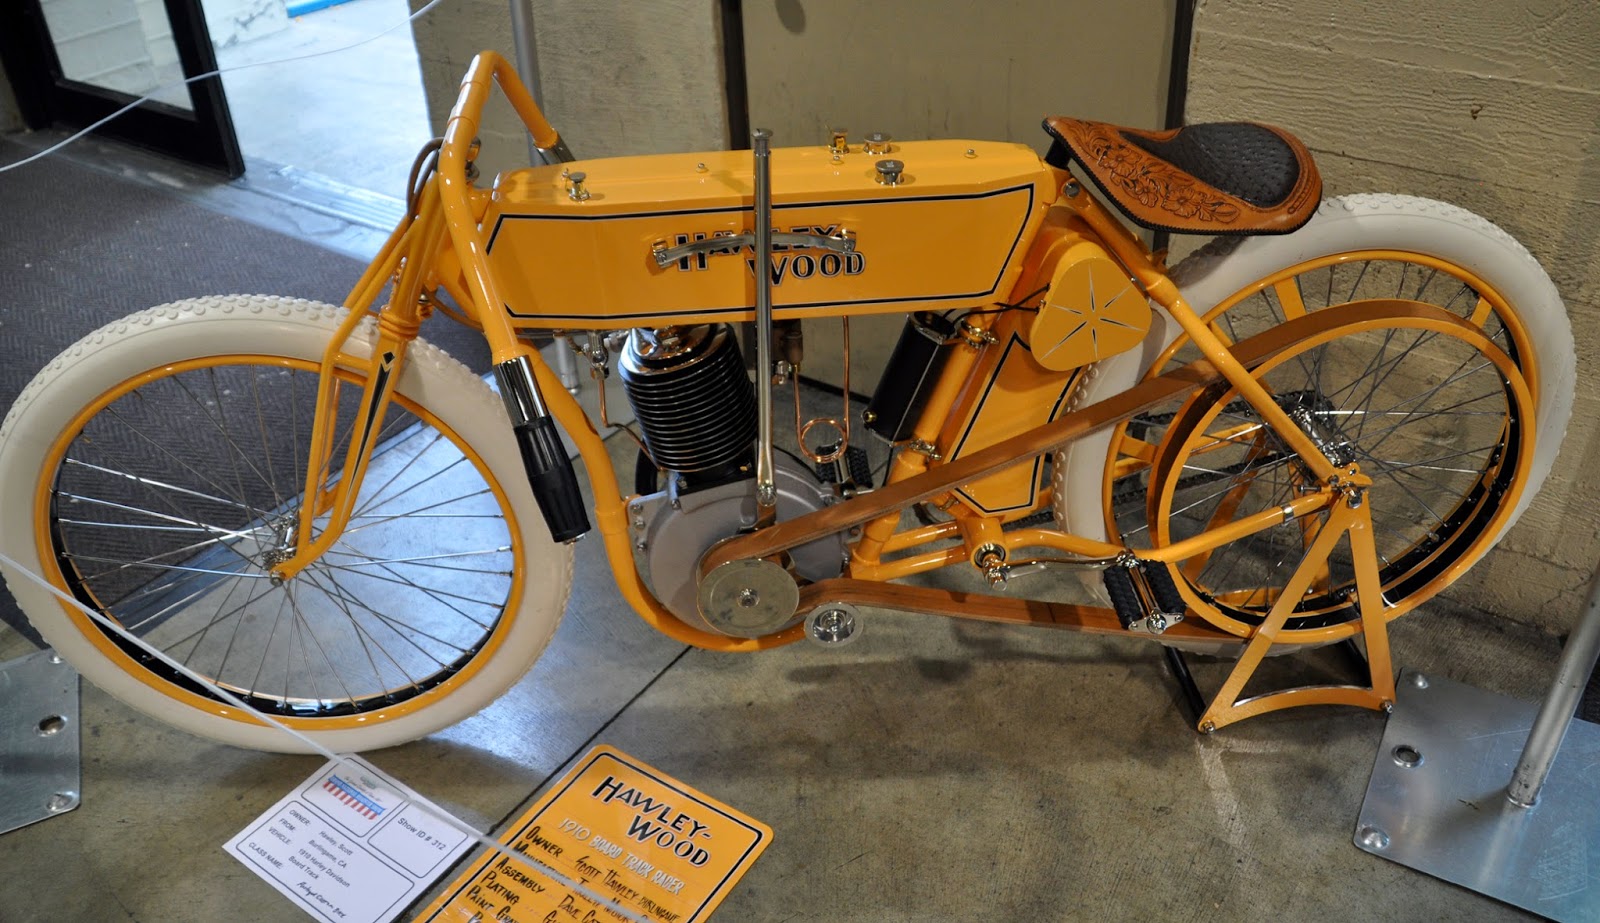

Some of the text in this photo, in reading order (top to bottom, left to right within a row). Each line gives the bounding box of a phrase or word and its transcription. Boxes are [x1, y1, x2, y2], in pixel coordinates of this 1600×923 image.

[591, 775, 712, 839] HAWLEY-
[337, 843, 354, 857] Scott
[397, 817, 418, 833] Show
[415, 829, 427, 839] ID
[431, 839, 447, 851] 312
[525, 825, 564, 859] OWNER
[627, 814, 710, 867] WOOD
[248, 842, 268, 858] CLASS
[288, 855, 306, 870] Board
[304, 866, 319, 880] Track
[310, 856, 327, 872] Harley
[325, 868, 351, 888] Davidson
[337, 859, 348, 869] CA
[559, 817, 686, 896] 1910 BOARD TRACK RACER
[479, 870, 520, 905] PLATING
[494, 856, 546, 894] ASSEMBLY
